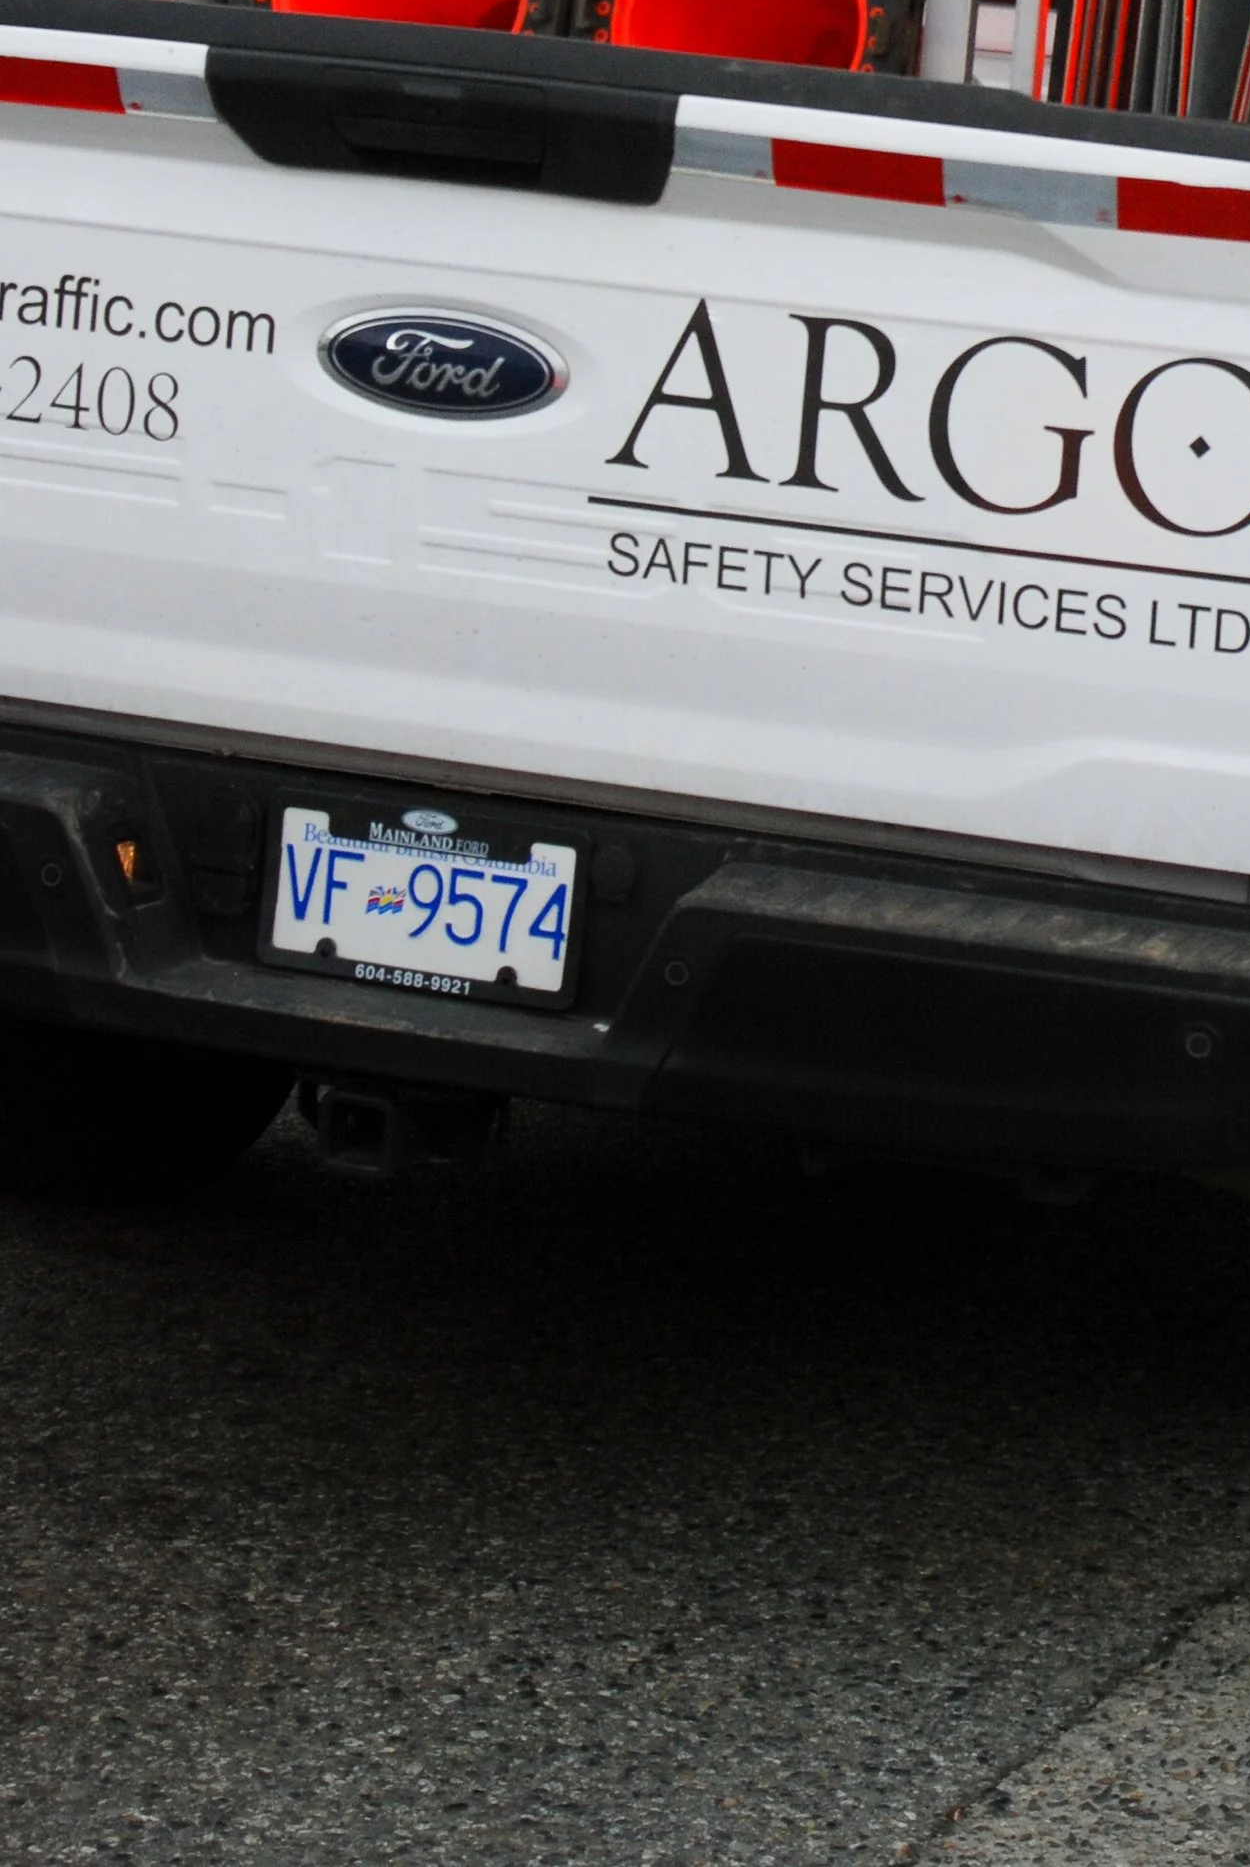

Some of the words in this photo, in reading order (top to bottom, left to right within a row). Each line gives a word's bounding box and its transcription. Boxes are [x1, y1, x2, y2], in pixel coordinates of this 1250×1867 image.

[0, 273, 276, 354] raffic.com
[371, 328, 505, 399] Ford
[607, 532, 822, 600] SAFETY
[841, 562, 1128, 640] SERVICES
[287, 843, 365, 925] VF
[408, 863, 569, 961] 9574
[354, 963, 471, 996] 604-588-9921
